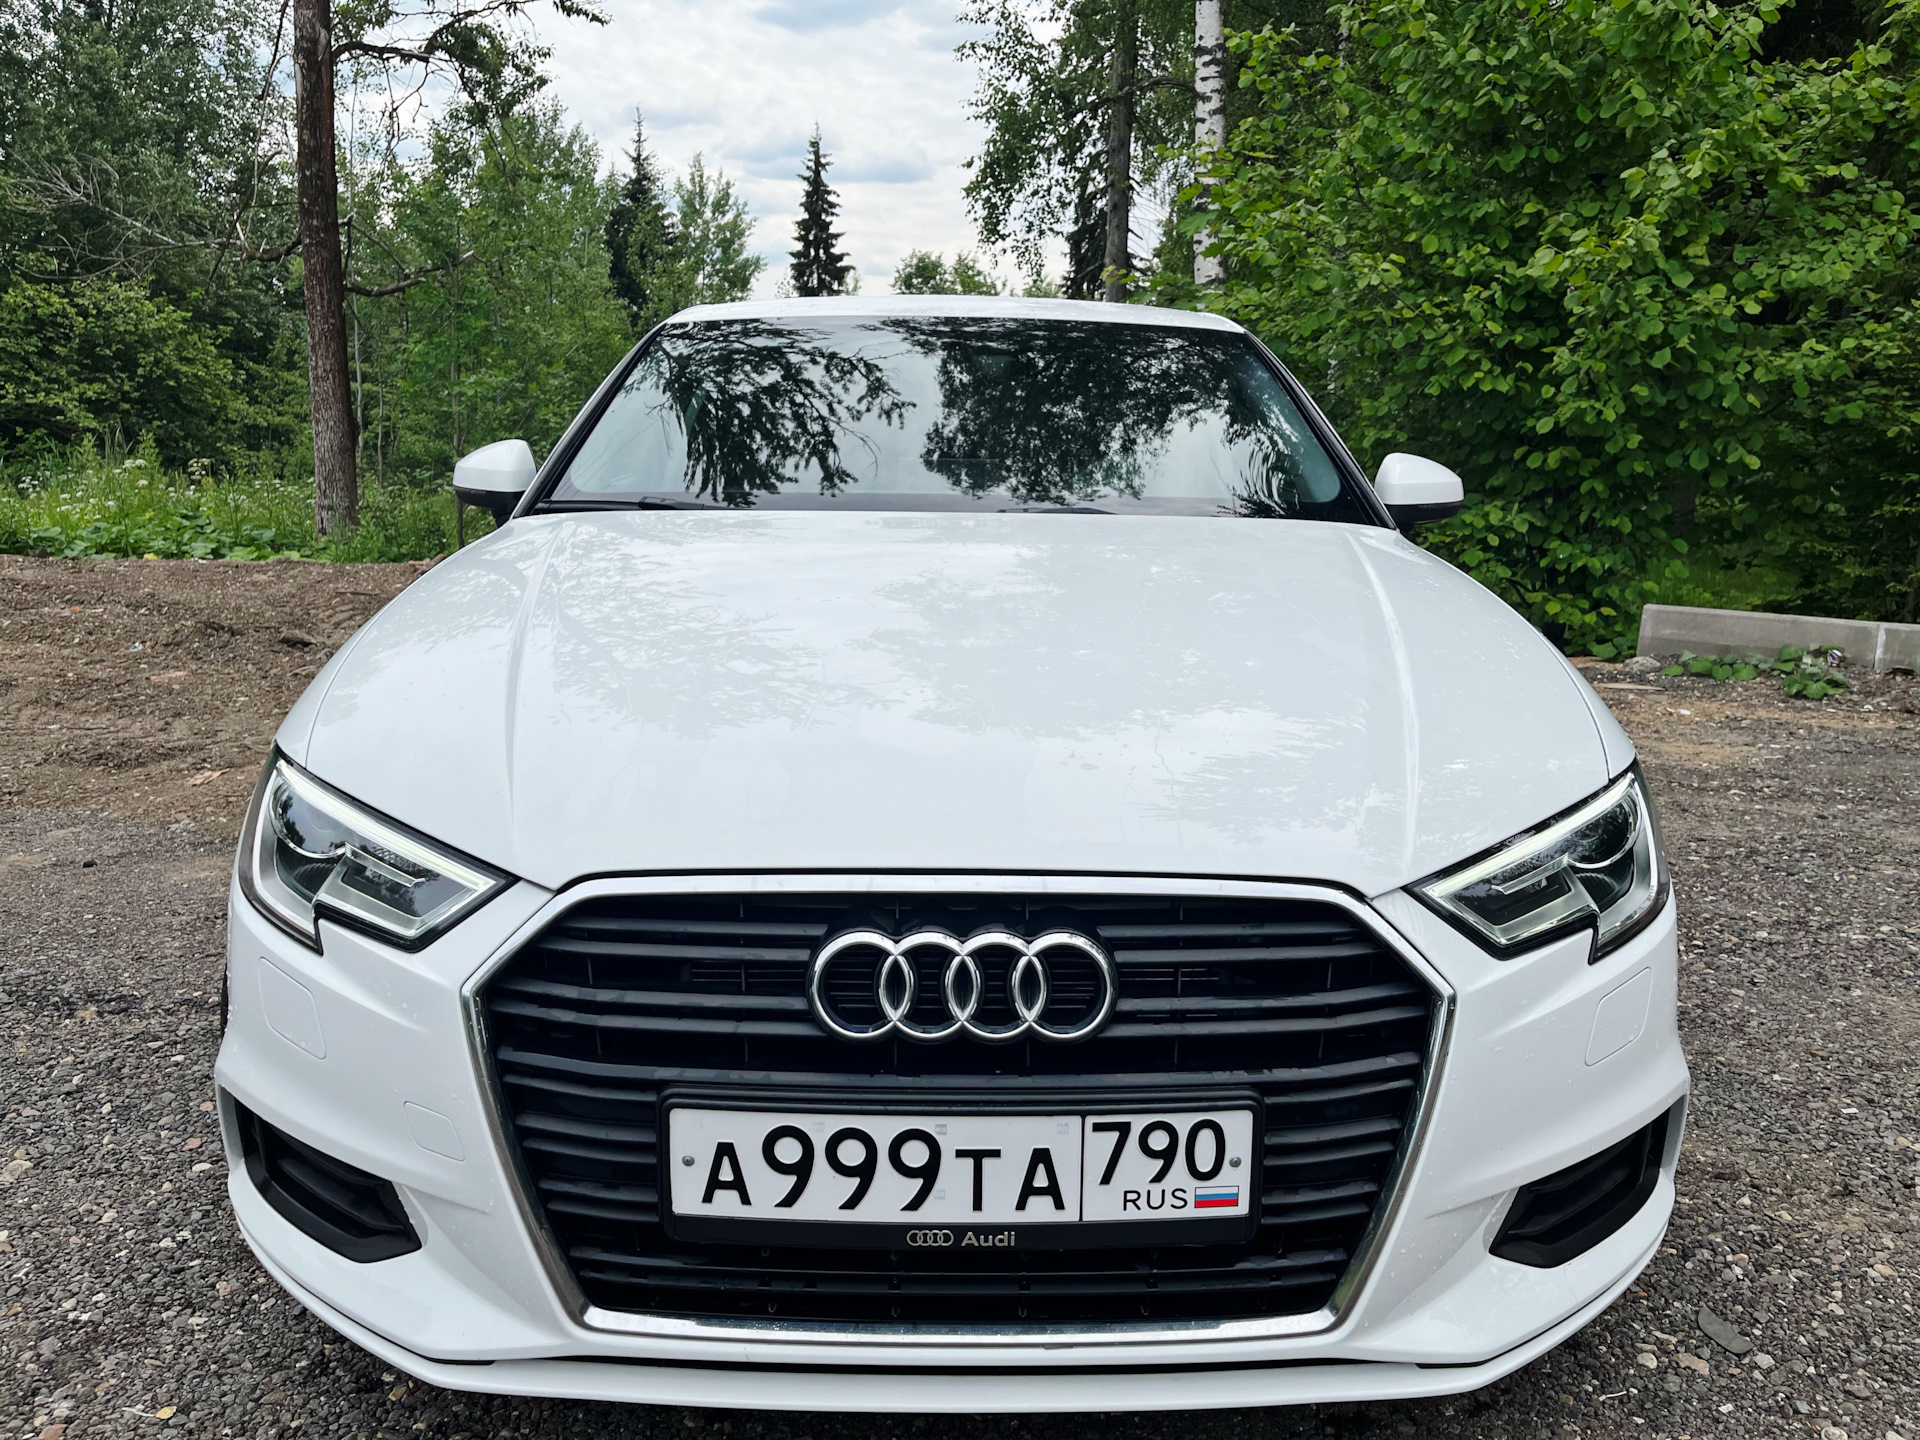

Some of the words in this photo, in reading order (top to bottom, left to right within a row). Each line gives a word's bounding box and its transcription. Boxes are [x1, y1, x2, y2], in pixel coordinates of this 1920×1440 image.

[701, 1124, 1066, 1212] A999TA
[1091, 1118, 1226, 1186] 790
[1122, 1188, 1188, 1212] RUS
[960, 1231, 1016, 1247] Audi
